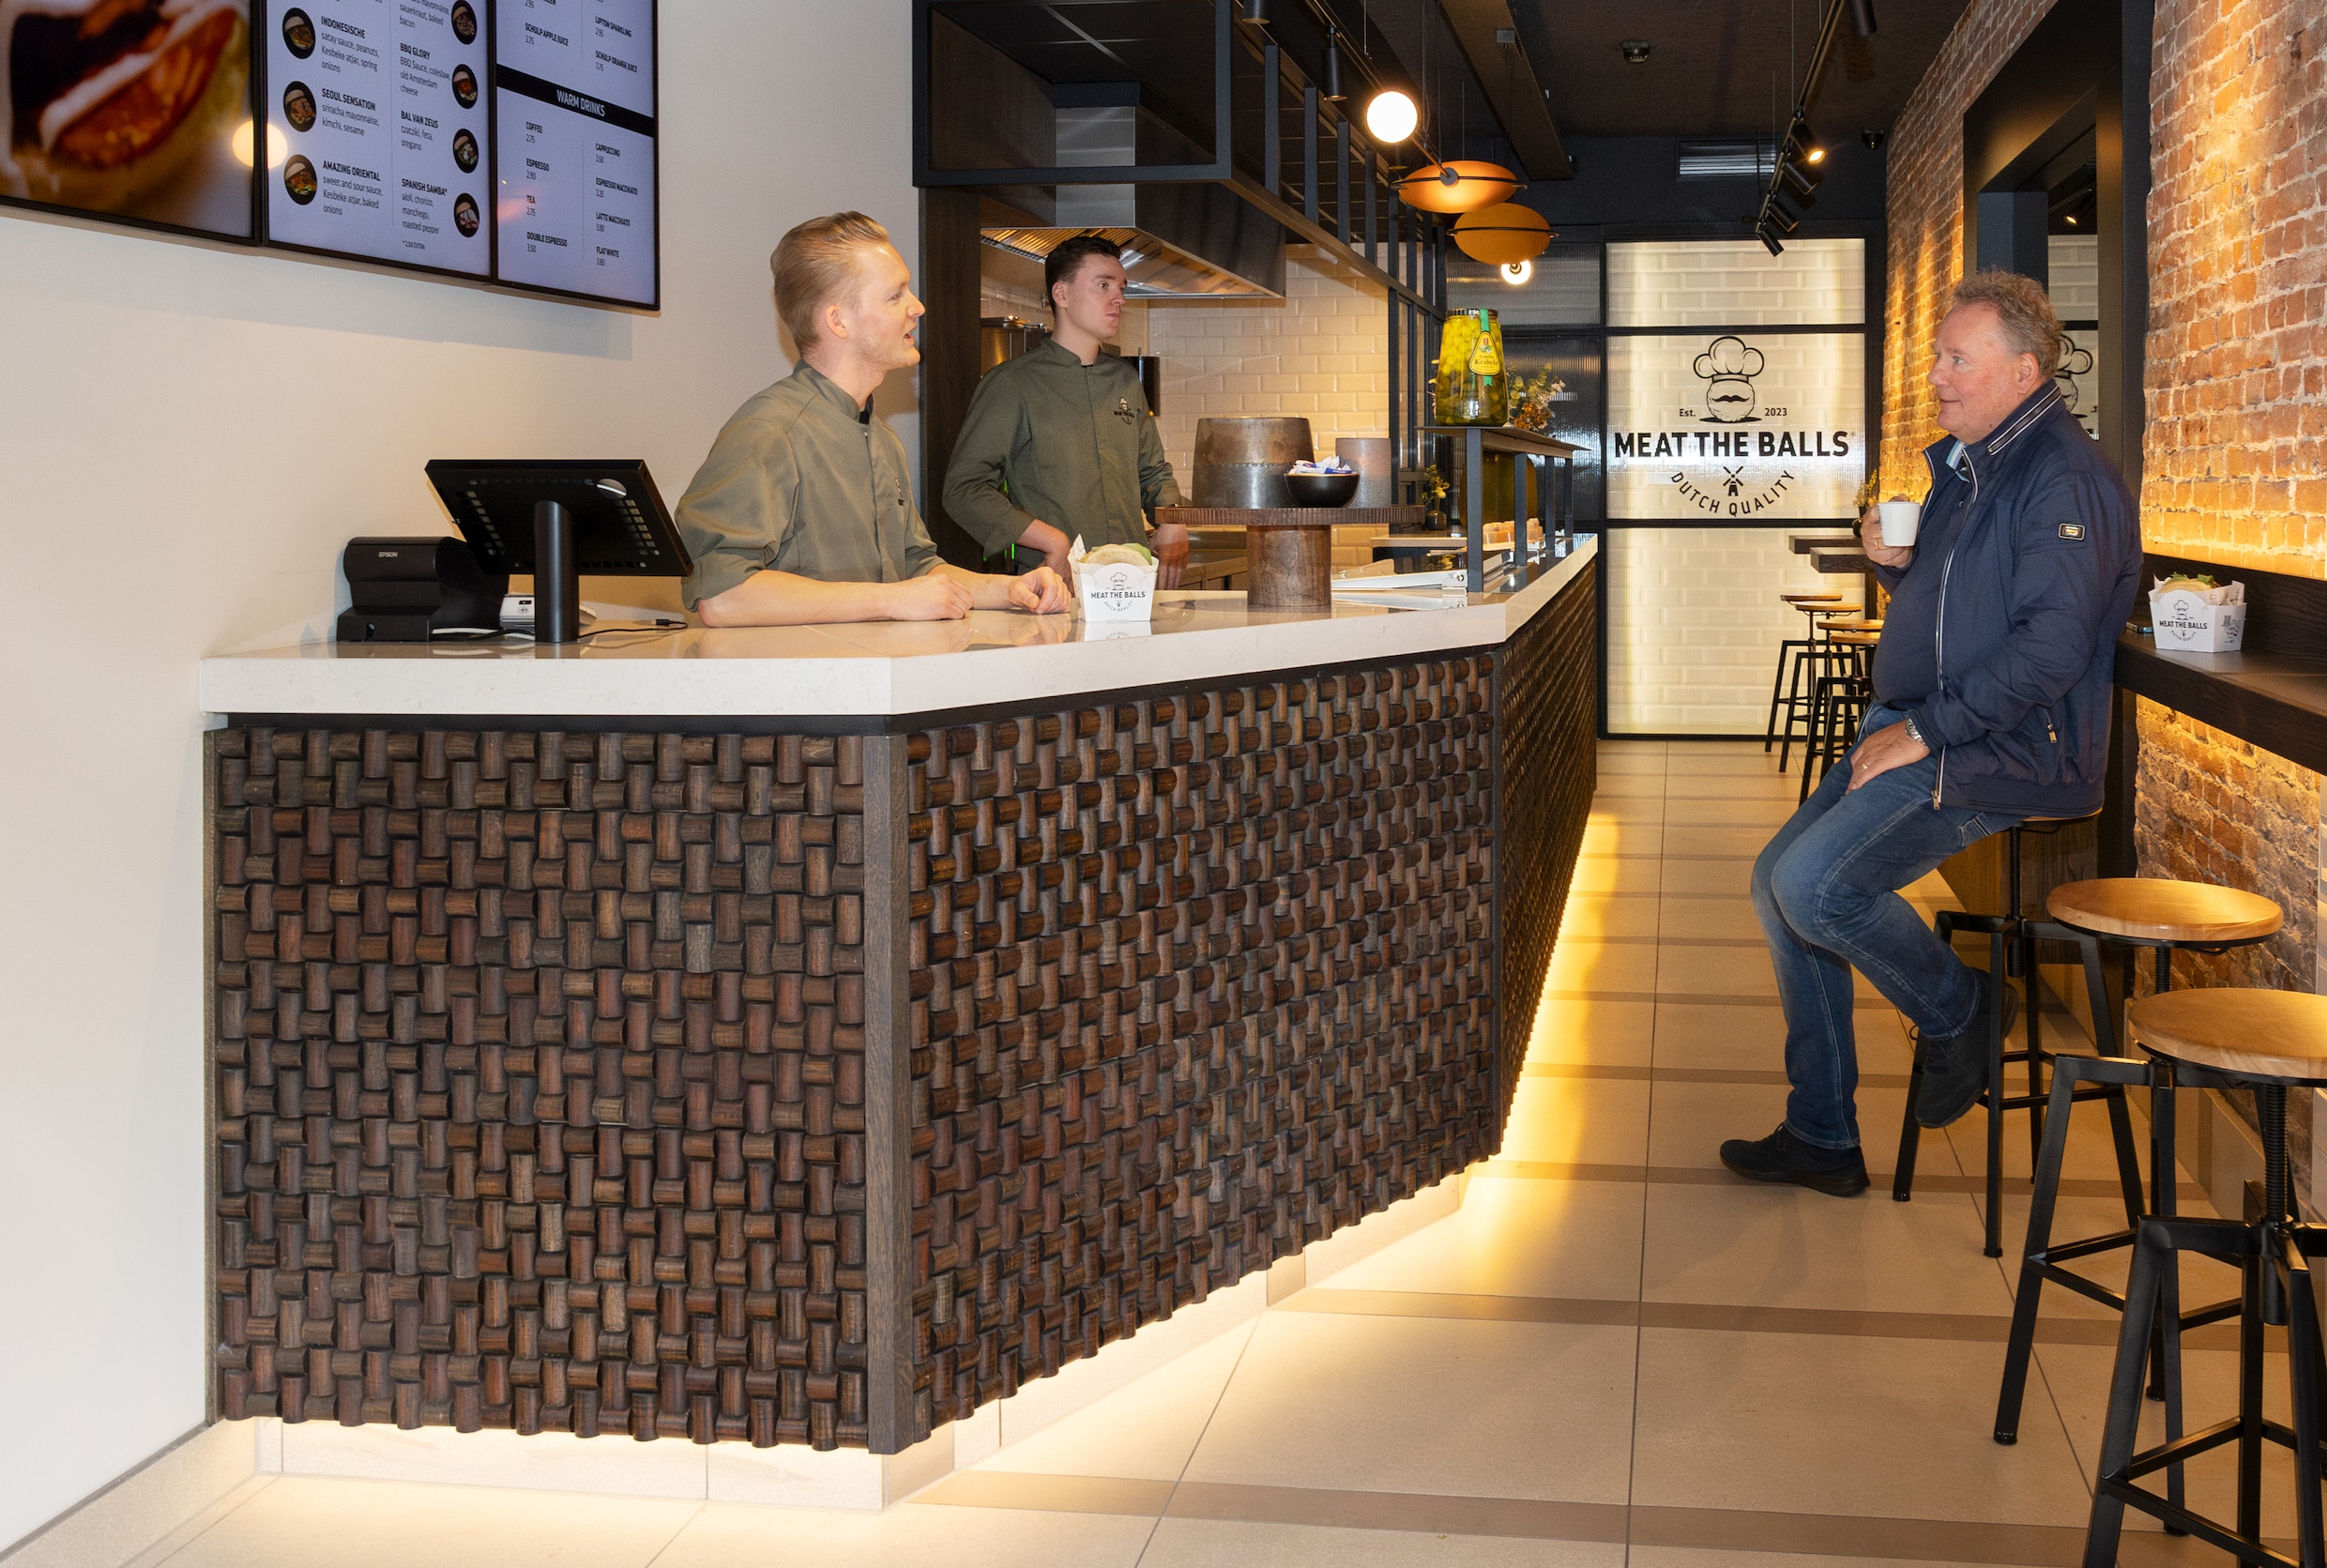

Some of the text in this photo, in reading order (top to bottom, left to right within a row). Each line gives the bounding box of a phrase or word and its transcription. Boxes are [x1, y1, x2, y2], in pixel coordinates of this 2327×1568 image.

[400, 4, 443, 25] sauerkraut, baked
[400, 15, 415, 28] bacon
[321, 16, 365, 38] INDONESISCHE
[595, 16, 609, 28] LIPTON
[525, 23, 569, 46] SCHULP APPLE JUICE
[321, 32, 379, 58] satay sauce, peanuts,
[400, 43, 430, 60] BBQ GLORY
[322, 46, 345, 60] Kesbeke
[361, 59, 377, 72] spring
[400, 56, 411, 68] BBQ
[322, 61, 341, 73] onions
[409, 74, 438, 89] Amsterdam
[401, 84, 418, 96] cheese
[322, 88, 375, 111] SEOUL SENSATION
[557, 90, 605, 117] WARM DRINKS
[322, 104, 379, 127] sriracha mayonnaise,
[401, 110, 438, 128] BAL VAN ZEUS
[322, 117, 364, 136] kimchi, sesame
[526, 121, 543, 133] COFFEE
[422, 129, 433, 141] feta,
[401, 139, 421, 151] oregano
[596, 143, 620, 157] CAPPUCCINO
[323, 160, 381, 181] AMAZING ORIENTAL
[526, 158, 549, 171] ESPRESSO
[323, 177, 340, 187] sweet
[342, 180, 352, 189] and
[366, 185, 383, 196] sauce,
[402, 178, 425, 191] SPANISH
[596, 177, 616, 189] ESPRESSO
[323, 189, 346, 202] Kesbeke
[363, 197, 379, 209] baked
[526, 195, 536, 204] TEA
[323, 205, 342, 215] onions
[596, 212, 608, 221] LATTE
[402, 221, 440, 234] roasted pepper
[527, 232, 567, 247] DOUBLE ESPRESSO
[596, 246, 605, 255] FLAT
[1679, 408, 1787, 417] Est. 2023
[1615, 431, 1849, 458] MEAT THE BALLS
[1671, 470, 1794, 517] DUTCH QUALITY
